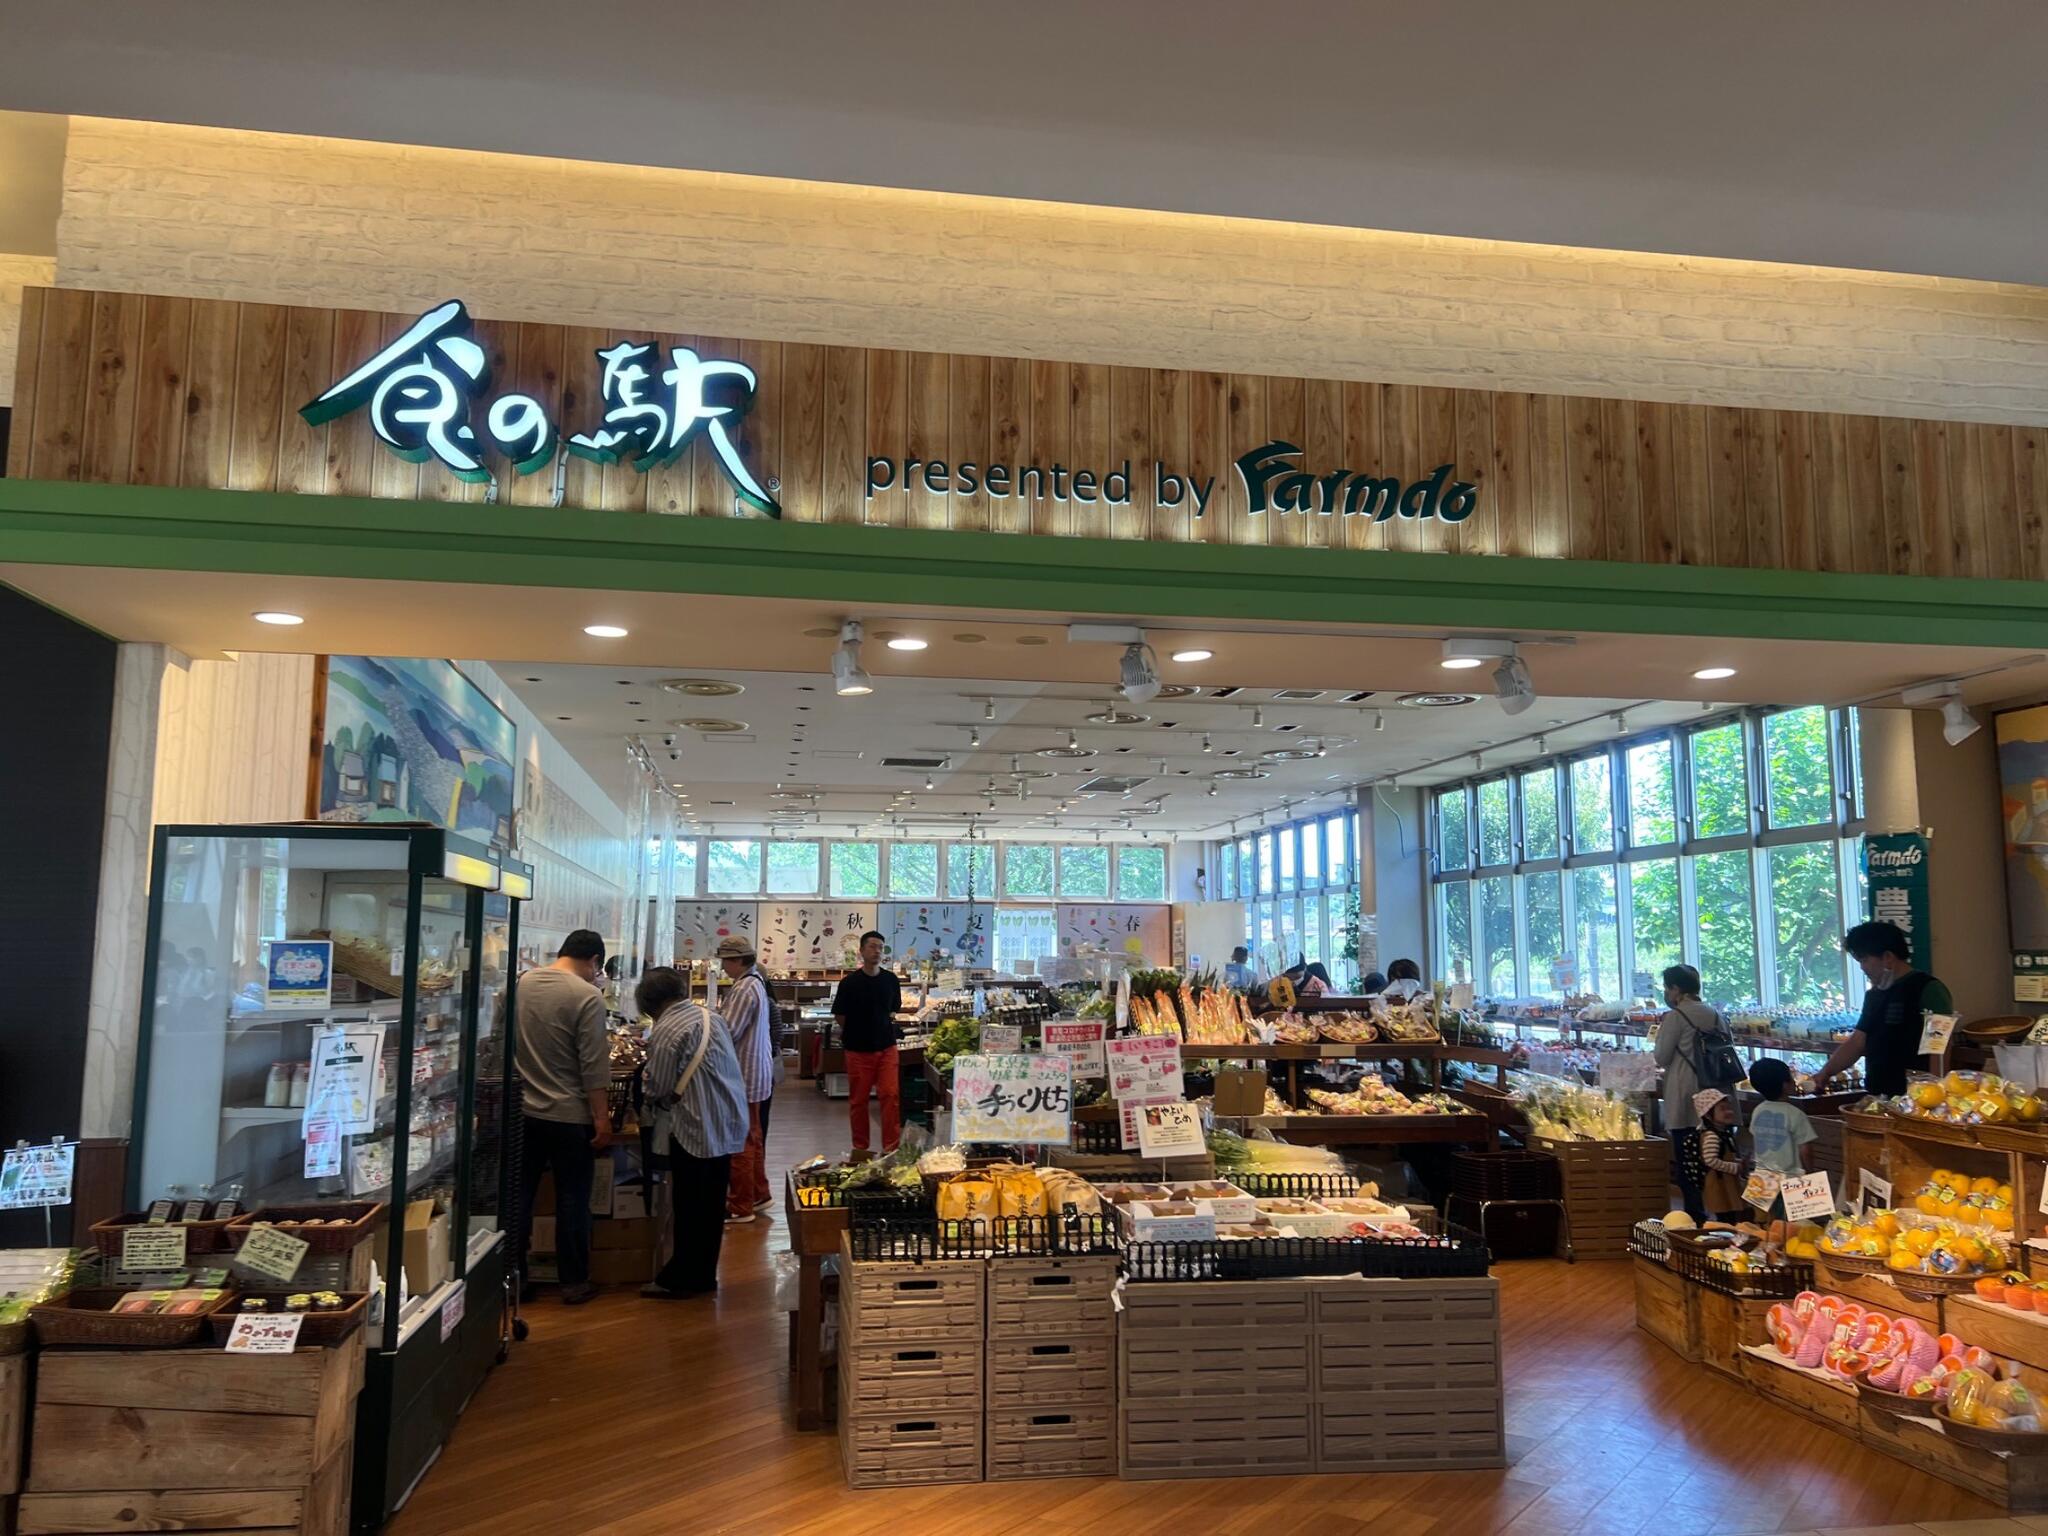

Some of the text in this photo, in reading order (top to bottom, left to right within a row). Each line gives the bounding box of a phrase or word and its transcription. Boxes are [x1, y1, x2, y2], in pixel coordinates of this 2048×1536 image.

[300, 299, 781, 519] 食の駅
[865, 440, 1479, 525] presented by Farmdo
[736, 912, 753, 931] 冬
[846, 912, 864, 930] 秋
[1126, 915, 1141, 932] 春
[976, 1084, 1069, 1117] 手づくりもち
[1160, 1106, 1183, 1117] やよい
